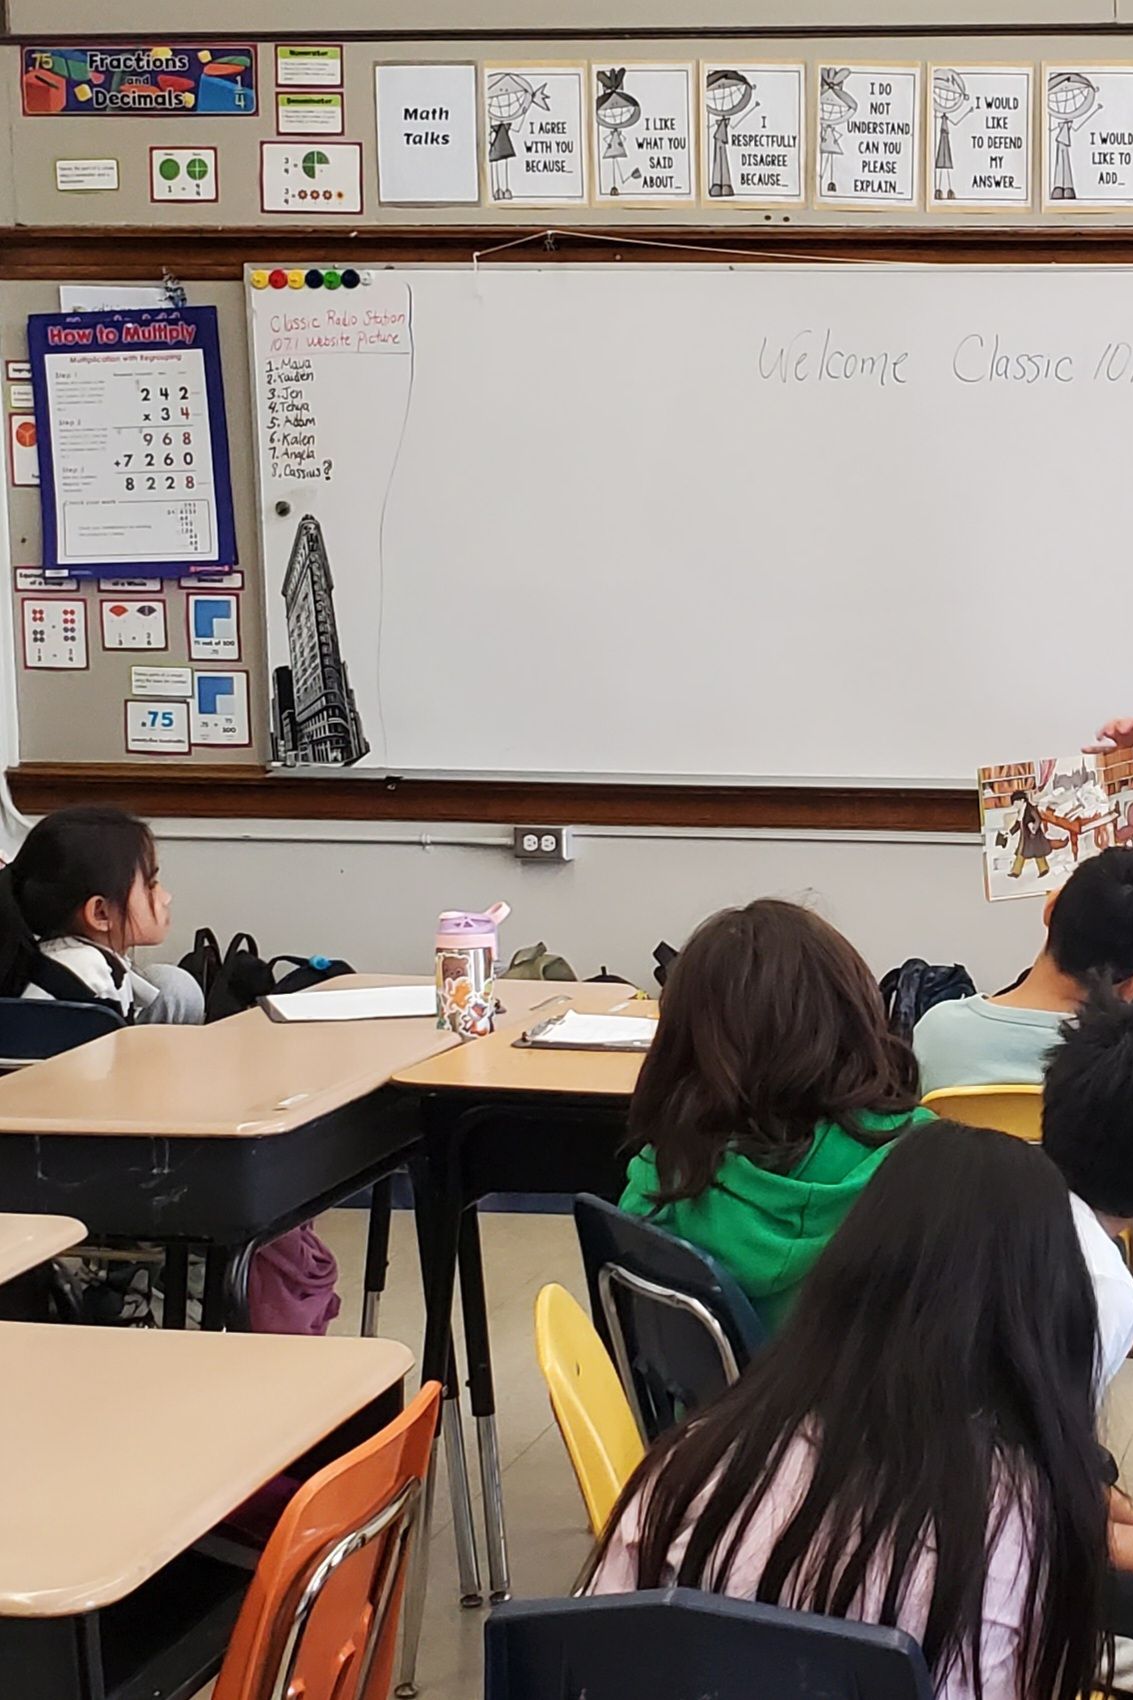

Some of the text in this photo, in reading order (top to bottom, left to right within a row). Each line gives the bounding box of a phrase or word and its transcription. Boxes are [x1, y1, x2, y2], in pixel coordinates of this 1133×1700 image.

[87, 52, 188, 71] Fractions
[126, 74, 150, 85] and
[870, 82, 892, 96] I DO
[94, 88, 185, 109] Decimals
[975, 97, 1019, 110] I WOULD
[403, 106, 449, 121] Math
[870, 102, 891, 115] NOT
[529, 121, 567, 134] I AGREE
[645, 118, 676, 131] I LIKE
[761, 116, 767, 129] I
[985, 116, 1008, 129] LIKE
[403, 131, 450, 145] Talks
[635, 137, 686, 150] WHAT YOU
[731, 134, 797, 148] RESPECTFULLY
[971, 136, 1023, 149] TO DEFEND
[1090, 131, 1133, 145] I WOULD
[524, 140, 574, 154] WITH YOU
[858, 141, 902, 155] CAN YOU
[649, 156, 674, 169] SAID
[741, 154, 788, 167] DISAGREE
[990, 156, 1004, 169] MY
[1092, 152, 1131, 165] LIKE TO
[862, 160, 897, 174] PLEASE
[270, 309, 406, 333] Classic Radio Station
[48, 321, 196, 345] How to Multiply
[70, 356, 120, 364] Multiplication
[758, 328, 910, 386] Welcome
[952, 333, 1075, 384] Classic
[141, 710, 174, 728] .75
